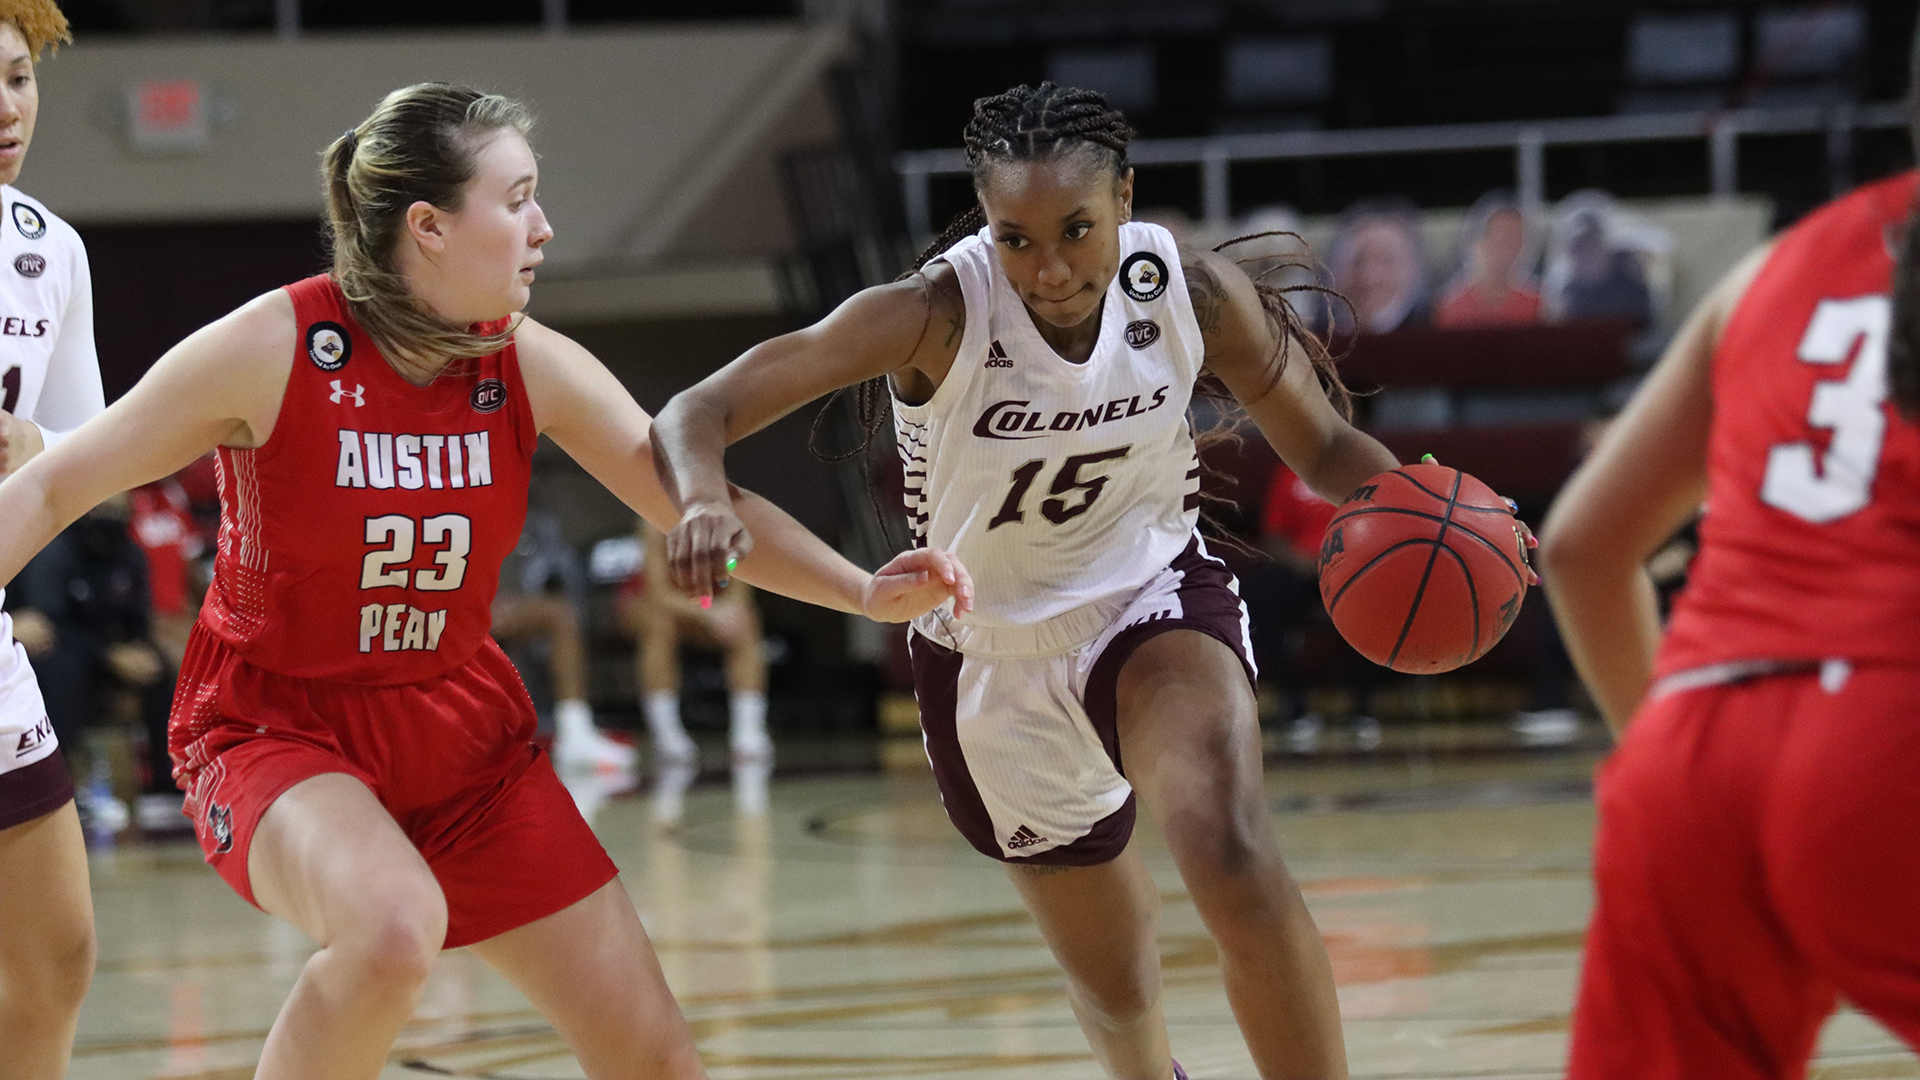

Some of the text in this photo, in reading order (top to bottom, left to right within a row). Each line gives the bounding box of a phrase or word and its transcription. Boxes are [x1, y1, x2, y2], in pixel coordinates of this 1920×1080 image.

[0, 317, 49, 337] ELS
[1128, 327, 1151, 343] OVC
[972, 385, 1169, 440] COLONELS
[1760, 293, 1892, 524] 3
[335, 428, 493, 490] AUSTIN
[986, 443, 1133, 532] 15
[359, 513, 472, 592] 23
[358, 603, 448, 653] PEAY
